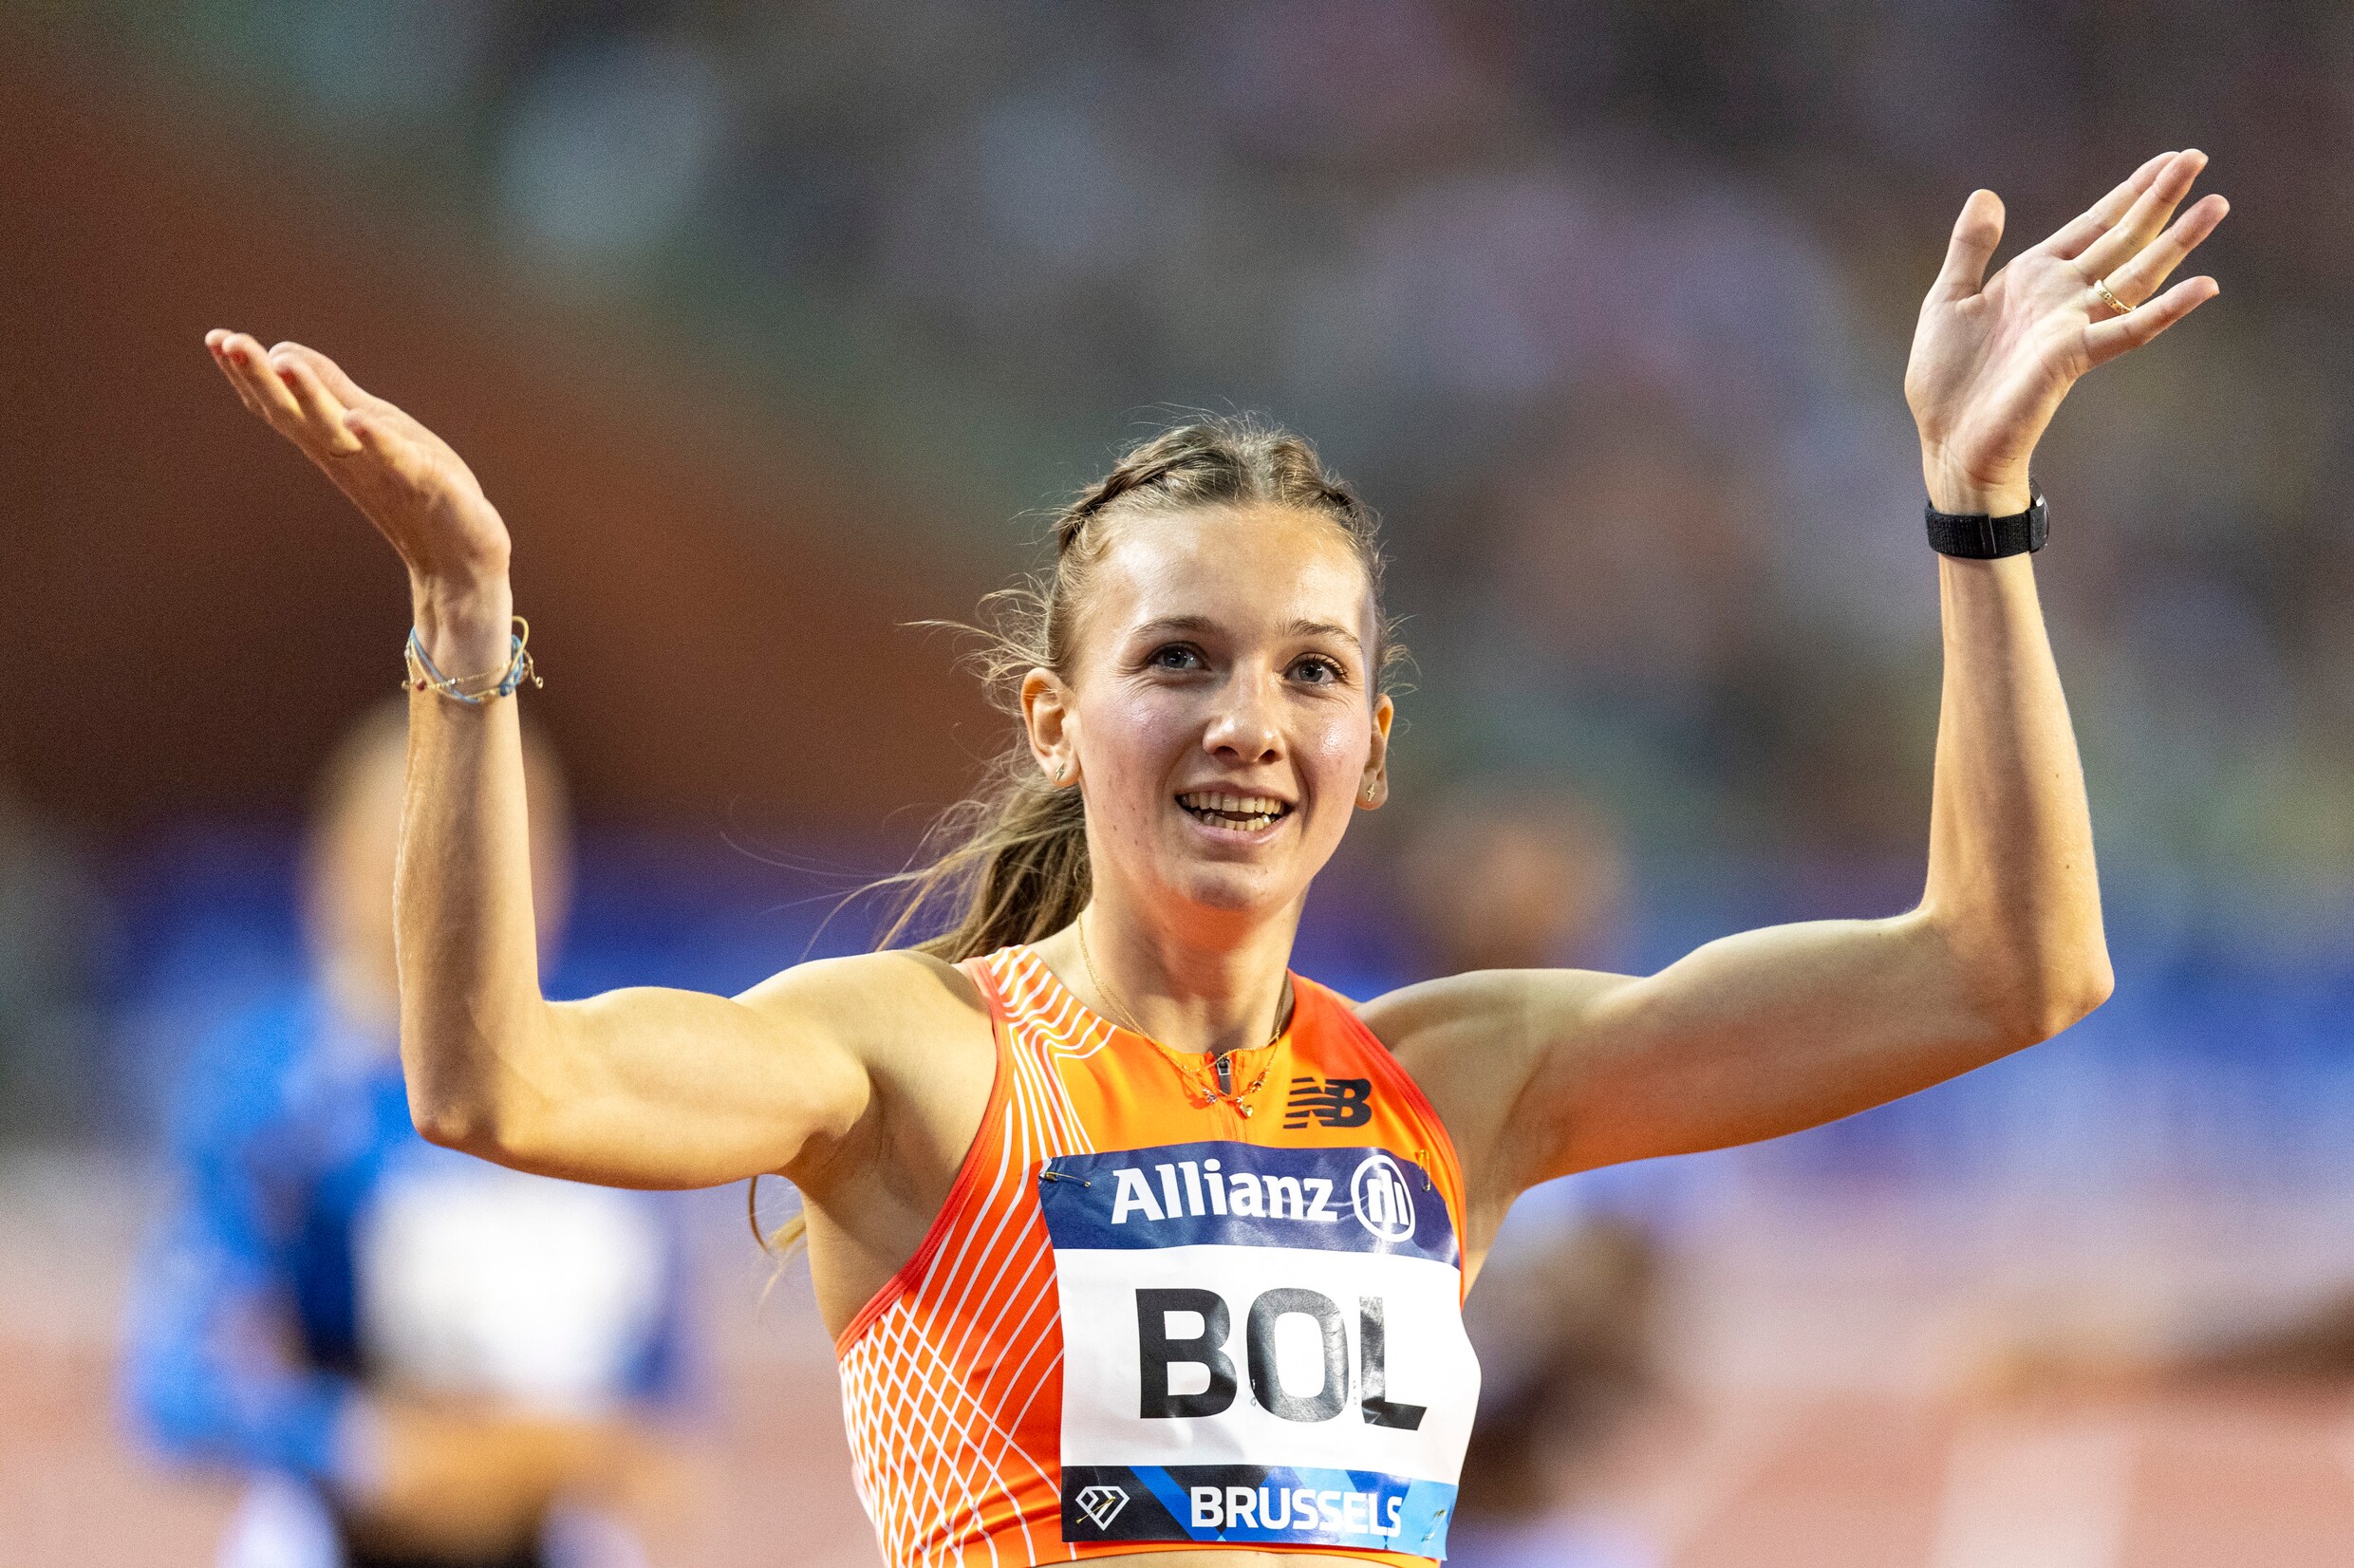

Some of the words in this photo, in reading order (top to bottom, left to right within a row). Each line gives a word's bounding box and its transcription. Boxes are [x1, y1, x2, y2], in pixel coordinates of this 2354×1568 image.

[1283, 1077, 1372, 1129] NB
[1111, 1159, 1337, 1223] Allianz
[1134, 1288, 1428, 1430] BOL
[1190, 1486, 1403, 1538] BRUSSELS
